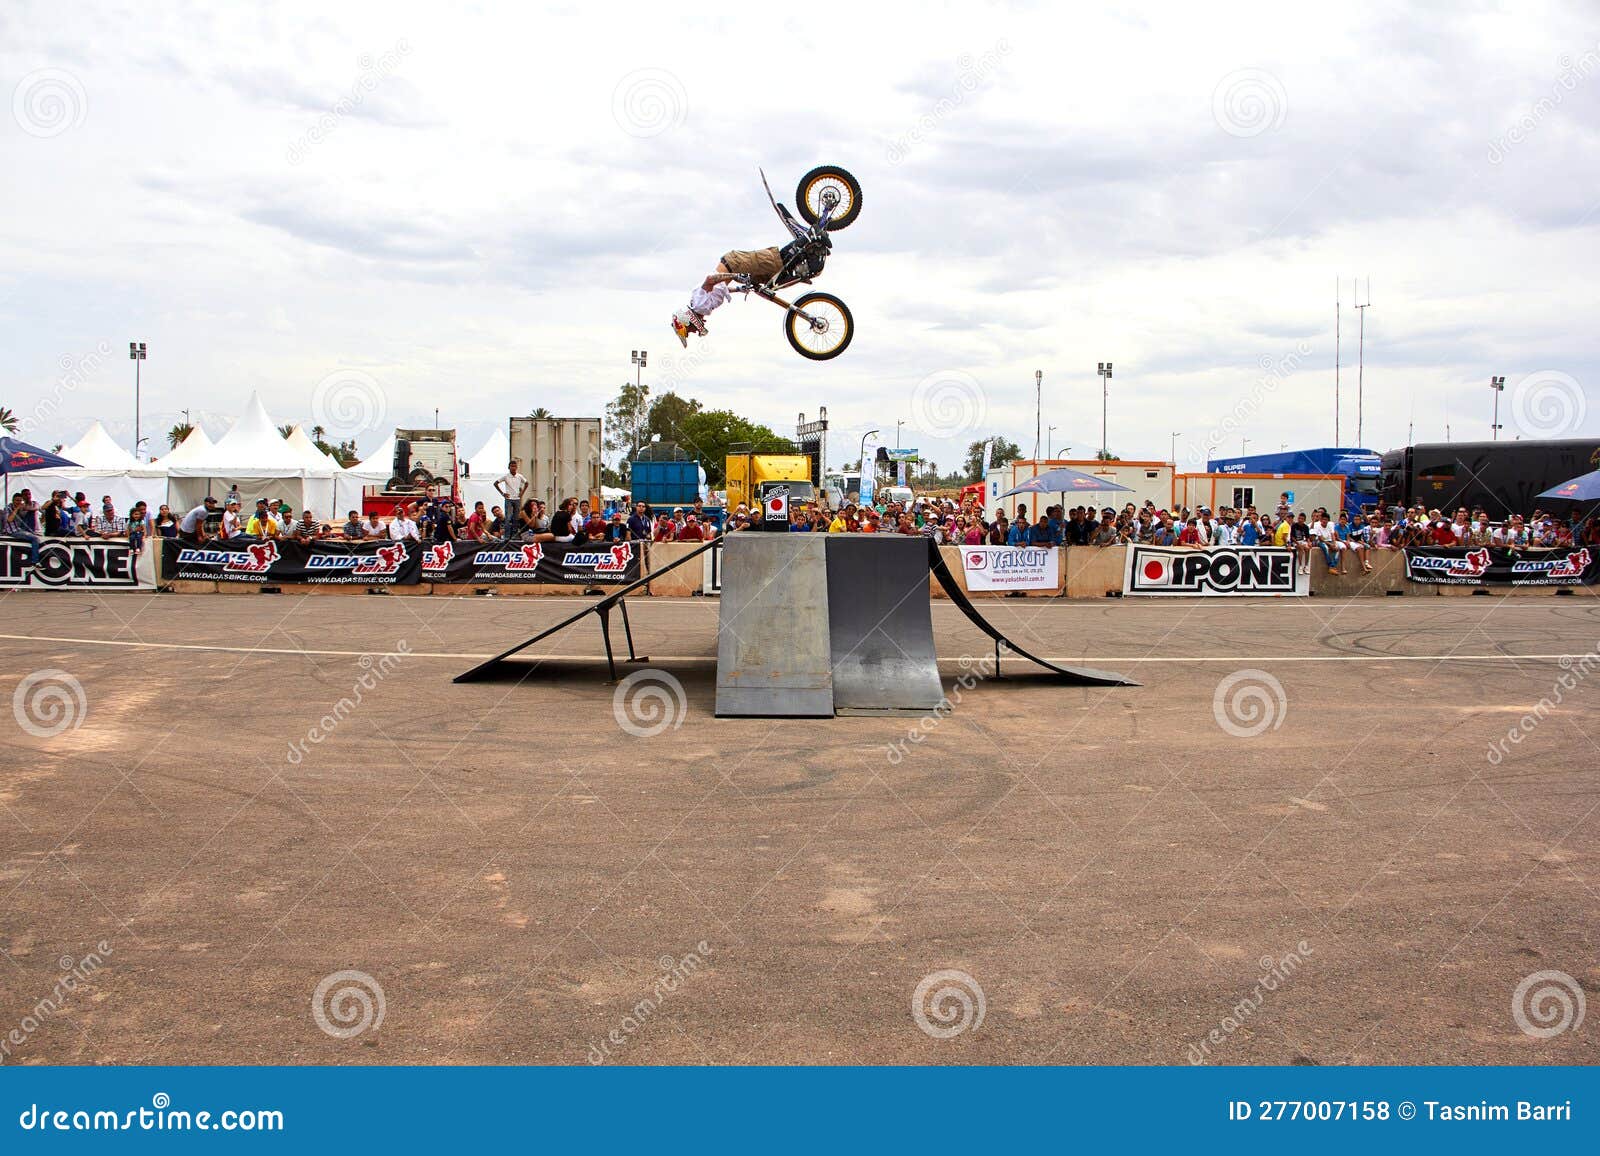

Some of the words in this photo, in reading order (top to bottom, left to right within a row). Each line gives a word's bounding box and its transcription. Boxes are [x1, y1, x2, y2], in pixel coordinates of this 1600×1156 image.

[177, 549, 251, 565] DADA'S
[306, 554, 379, 568] DADA'S
[474, 551, 523, 564] DADA'S
[562, 553, 613, 566] DADA'S
[989, 550, 1048, 568] YAKUT
[1411, 556, 1467, 569] DADA'S
[1172, 554, 1290, 586] IPONE
[1512, 560, 1568, 572] DADA'S
[178, 572, 268, 582] WWW.DADASBIKE.COM
